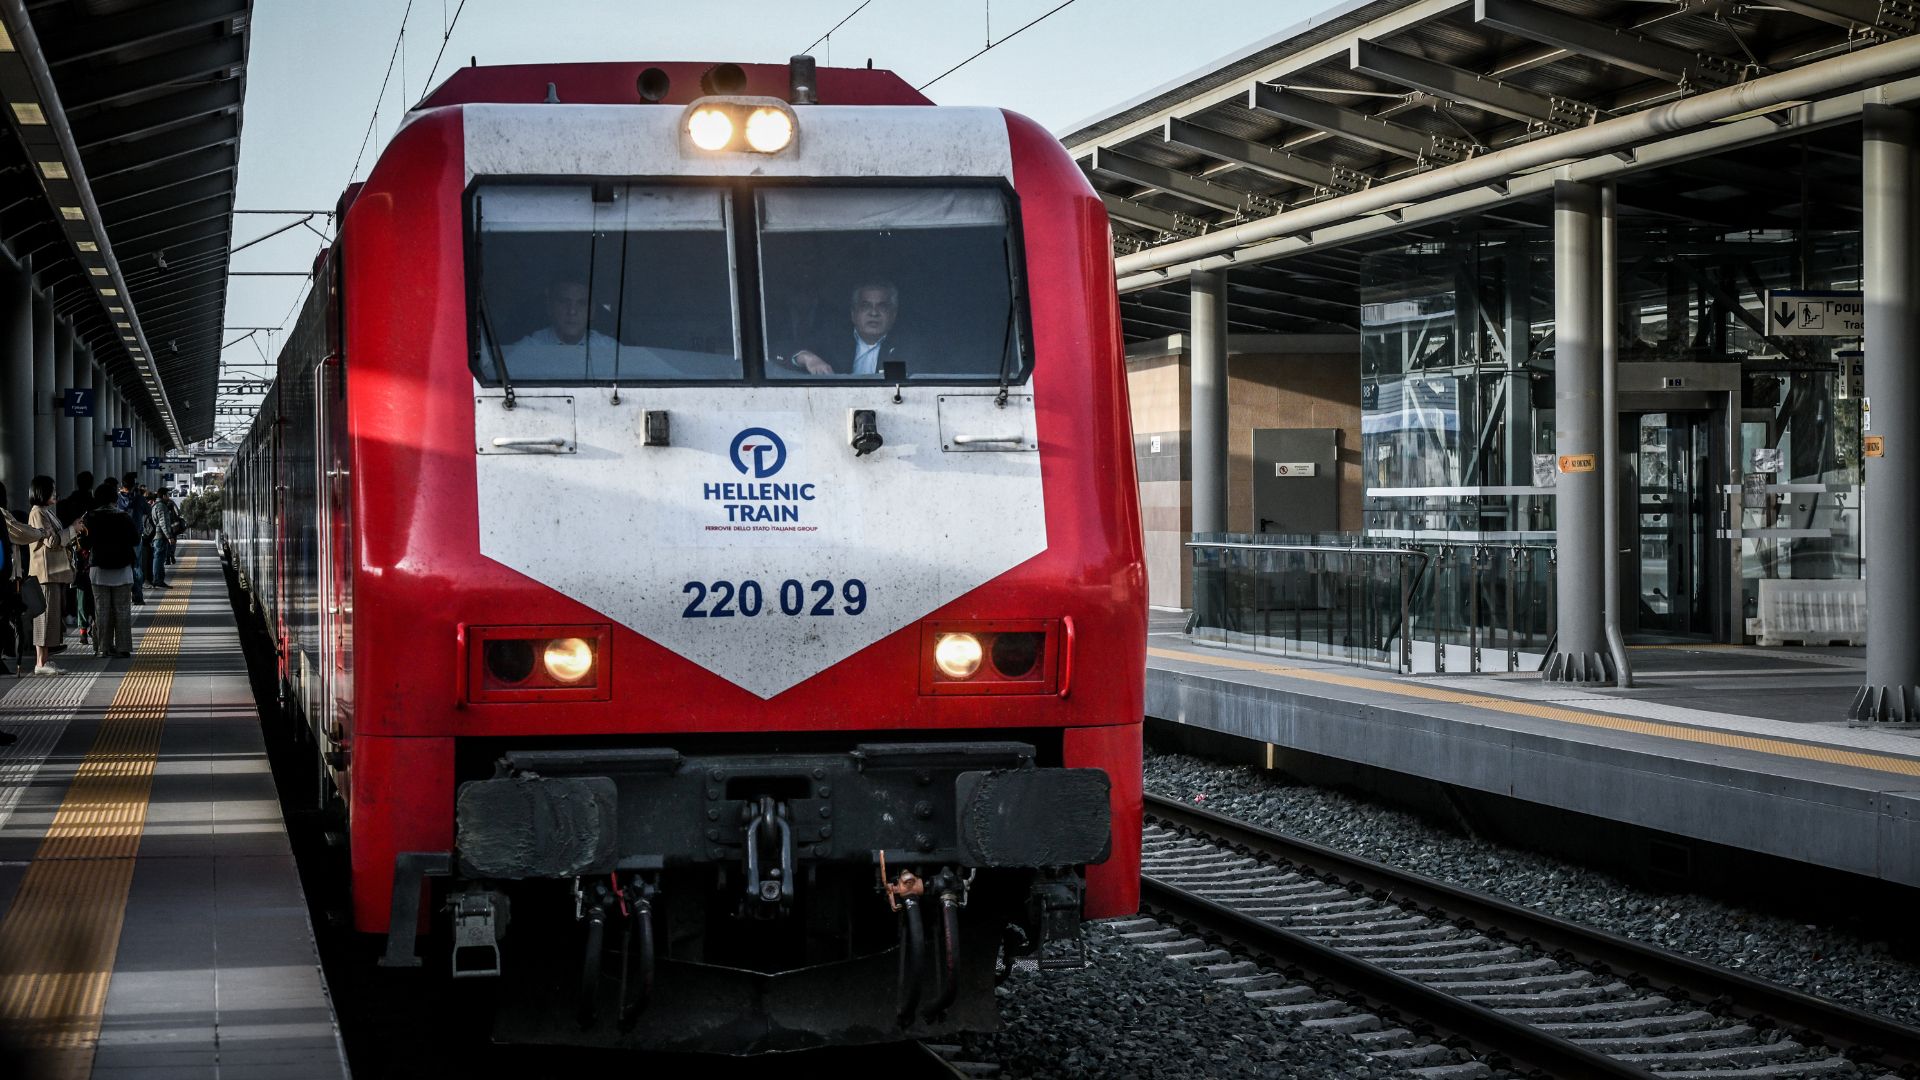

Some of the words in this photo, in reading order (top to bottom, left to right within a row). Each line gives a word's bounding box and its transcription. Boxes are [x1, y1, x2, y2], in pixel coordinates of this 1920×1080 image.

[75, 391, 84, 404] 7
[118, 430, 125, 439] 7
[703, 482, 816, 501] HELLENIC
[723, 504, 799, 522] TRAIN
[682, 580, 763, 618] 220
[779, 579, 867, 616] 029
